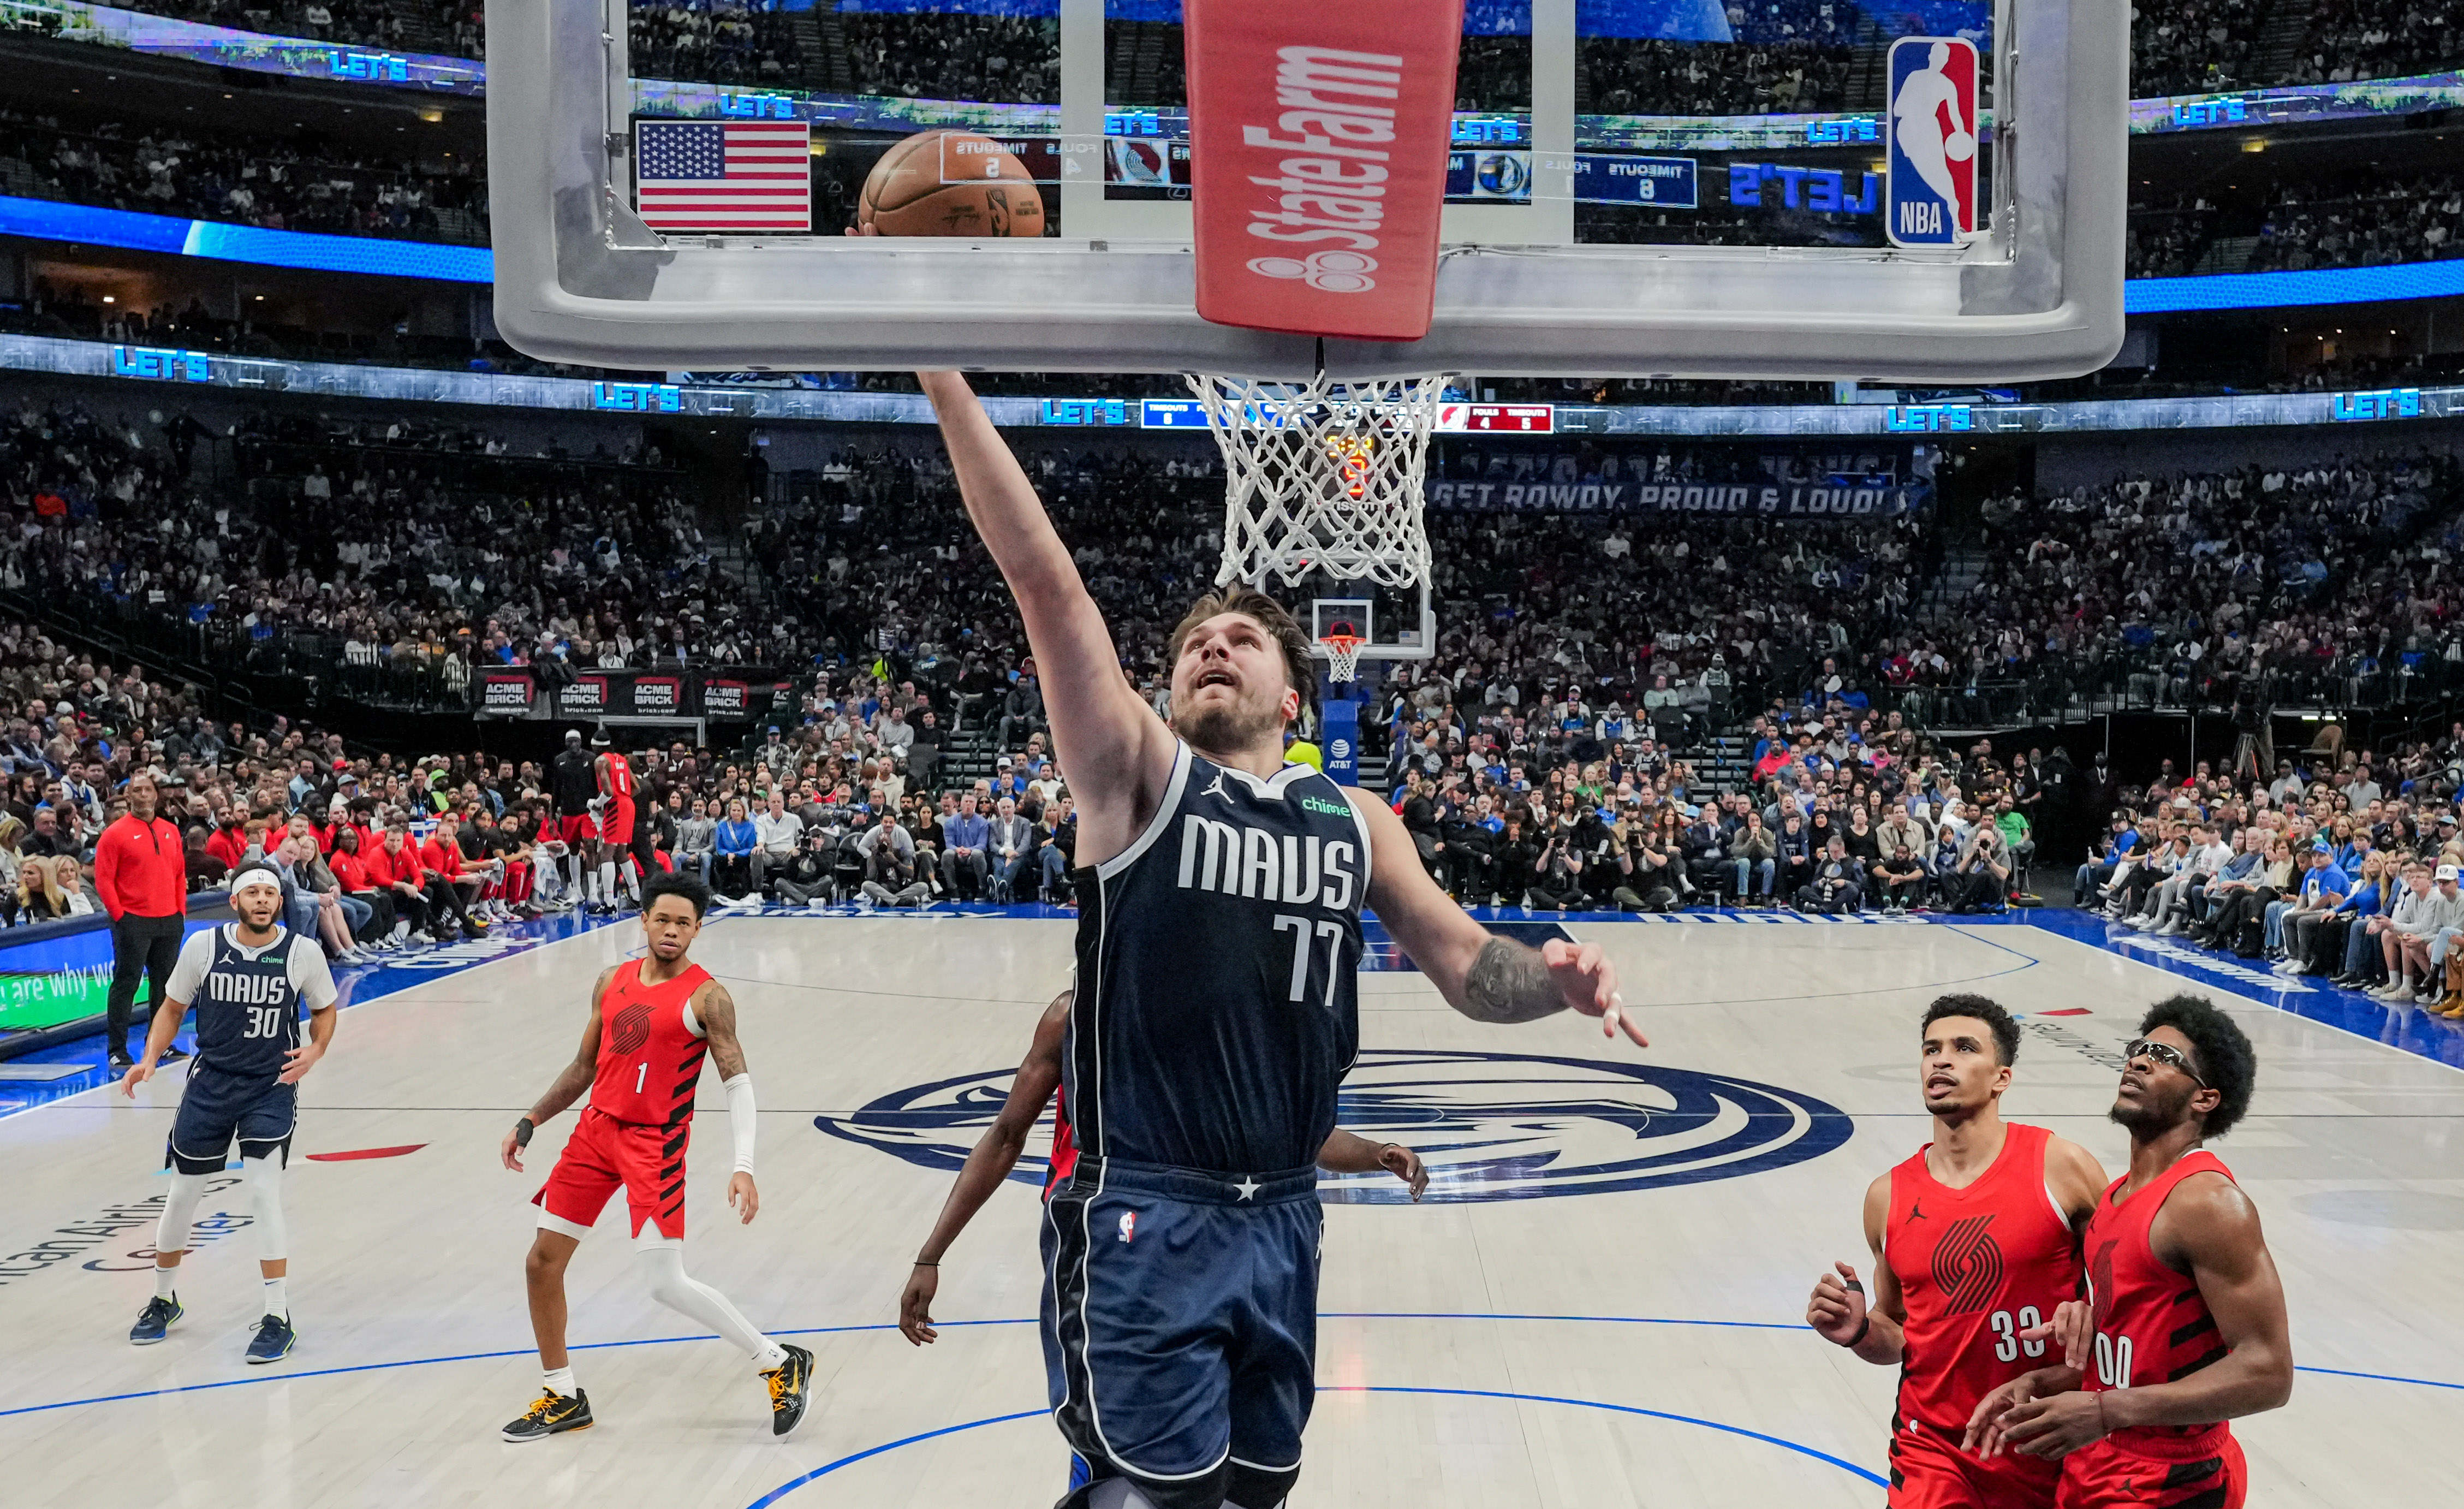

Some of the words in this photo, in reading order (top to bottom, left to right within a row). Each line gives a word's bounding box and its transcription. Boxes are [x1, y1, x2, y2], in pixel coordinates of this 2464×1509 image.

[330, 50, 408, 81] LET'S
[721, 93, 793, 118] LET'S
[2174, 97, 2245, 126] LET'S
[1104, 110, 1158, 134] ET'S
[1452, 117, 1519, 141] LET'S
[1807, 117, 1876, 142] LET'S
[1900, 201, 1943, 235] NBA
[115, 345, 210, 382] LET'S
[594, 382, 681, 412] LET'S
[2335, 388, 2421, 420] LET'S
[1043, 397, 1124, 425] LET'S
[1480, 417, 1490, 430] 4
[1521, 417, 1532, 430] 5
[1888, 405, 1972, 432] LET'S
[485, 694, 526, 704] BRICK
[486, 684, 525, 693] ACME
[561, 684, 600, 694] ACME
[561, 694, 600, 704] BRICK
[634, 695, 672, 705] BRICK
[635, 685, 672, 695] ACME
[705, 687, 741, 698] ACME
[705, 697, 741, 708] BRICK
[1329, 760, 1352, 769] AT&T
[1302, 795, 1352, 818] chime
[1177, 814, 1354, 911] MAVS
[261, 956, 284, 964] chime
[1272, 914, 1344, 1007] 77
[12, 977, 44, 1001] are
[48, 962, 87, 1001] why
[210, 972, 286, 1005] MAVS
[243, 1006, 282, 1039] 30
[635, 1062, 648, 1094] 1
[1990, 1304, 2046, 1362] 33
[2095, 1331, 2133, 1390] 00
